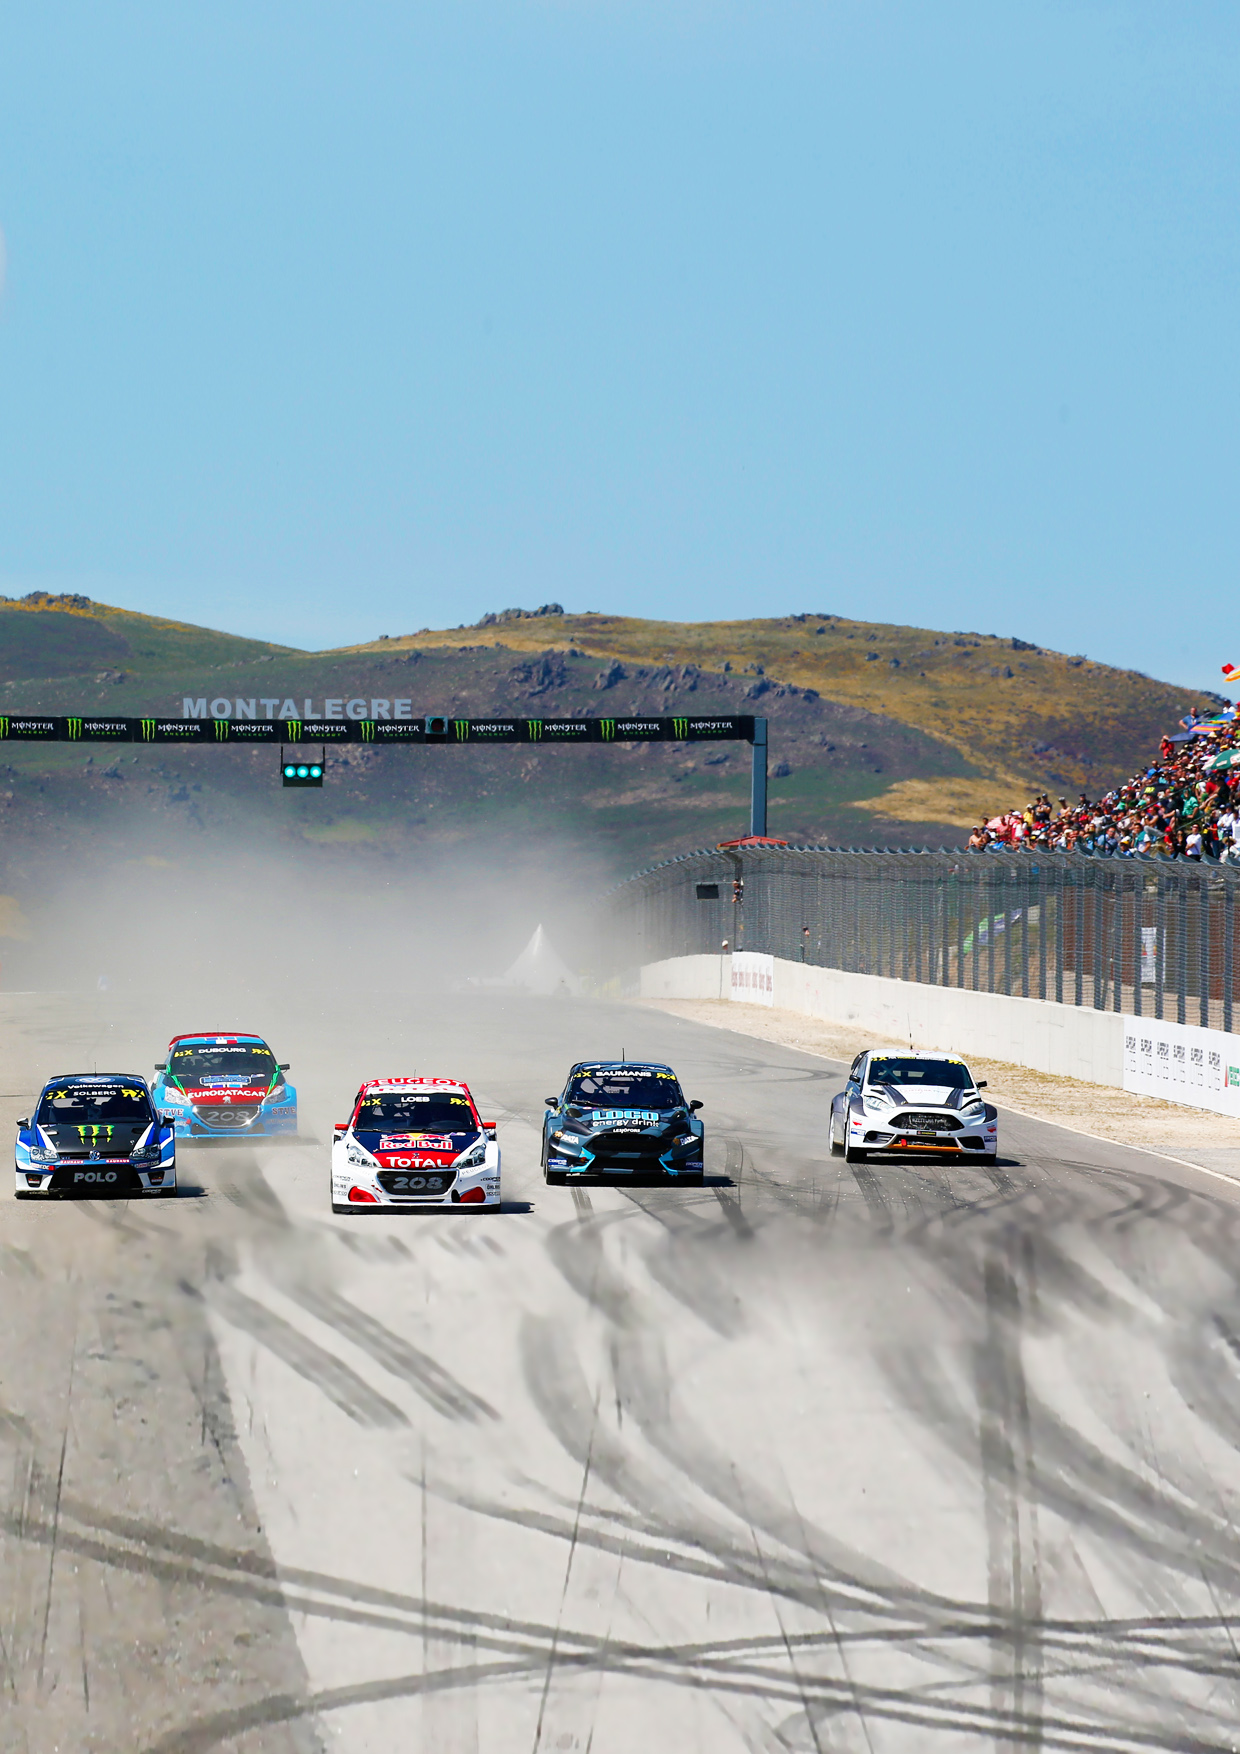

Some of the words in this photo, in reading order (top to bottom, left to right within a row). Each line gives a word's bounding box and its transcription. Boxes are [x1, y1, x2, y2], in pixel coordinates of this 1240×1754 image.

[182, 697, 412, 720] MONTALEGRE
[11, 721, 54, 731] MONSTER
[84, 722, 127, 731] MONSTER
[158, 723, 201, 732] MONSTER
[231, 724, 274, 733] MONSTER
[304, 724, 347, 733] MONSTER
[377, 724, 420, 733] MONSTER
[471, 723, 514, 732] MONSTER
[544, 723, 587, 731] MONSTER
[617, 722, 660, 731] MONSTER
[690, 721, 733, 729] MONSTER
[363, 1078, 467, 1088] PEUGEOT
[187, 1089, 266, 1099] EURODATACAR
[206, 1111, 250, 1121] 208
[592, 1110, 659, 1121] LOCO
[592, 1119, 629, 1127] energy
[632, 1118, 659, 1127] drink
[380, 1140, 416, 1149] Red
[417, 1140, 453, 1150] Bull
[386, 1156, 449, 1168] TOTAL
[73, 1172, 118, 1183] POLO
[392, 1177, 443, 1190] 208
